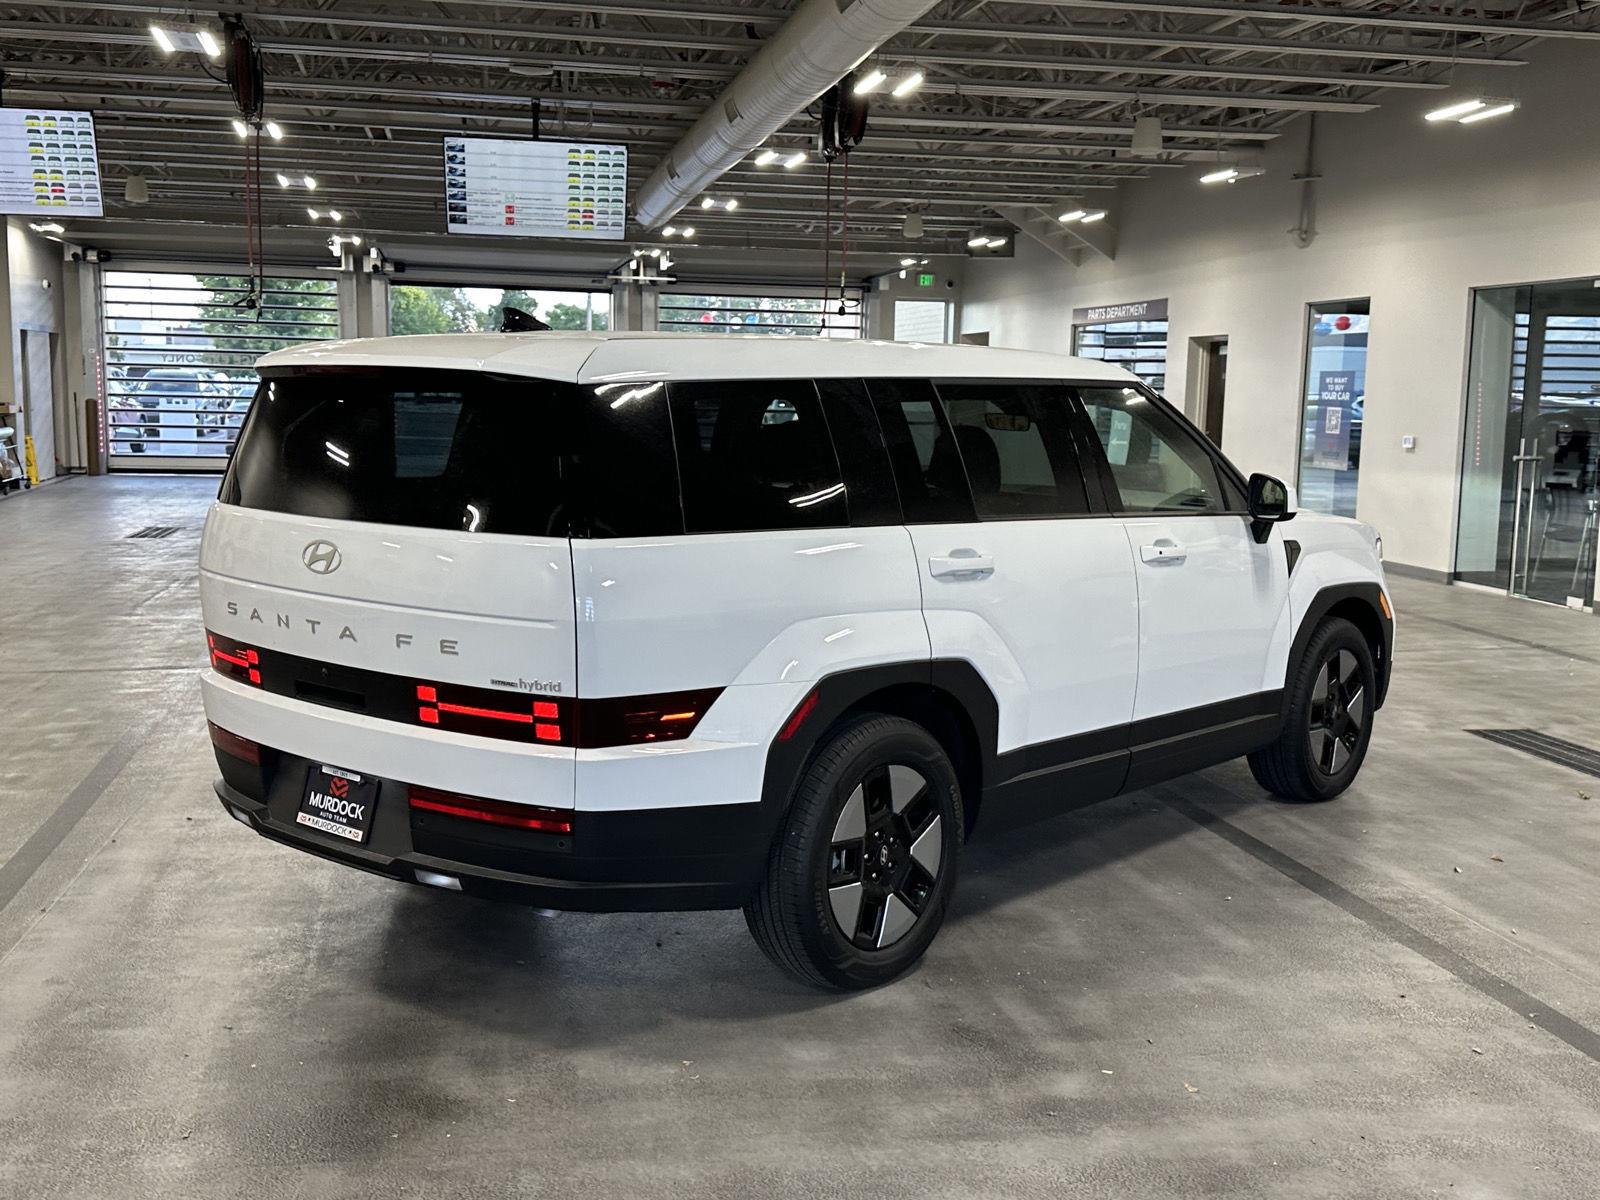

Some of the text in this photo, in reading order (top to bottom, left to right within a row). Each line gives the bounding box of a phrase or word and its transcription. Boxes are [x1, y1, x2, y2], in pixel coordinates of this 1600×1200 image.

[1087, 303, 1147, 320] PARTS DEPARTMENT
[1321, 391, 1350, 400] YOUR CAR
[227, 602, 459, 656] SANTA FE
[519, 677, 562, 692] hybrid
[309, 791, 365, 820] MURDOCK
[320, 811, 347, 823] AUTO TEAM
[310, 818, 347, 836] MURDOCK
